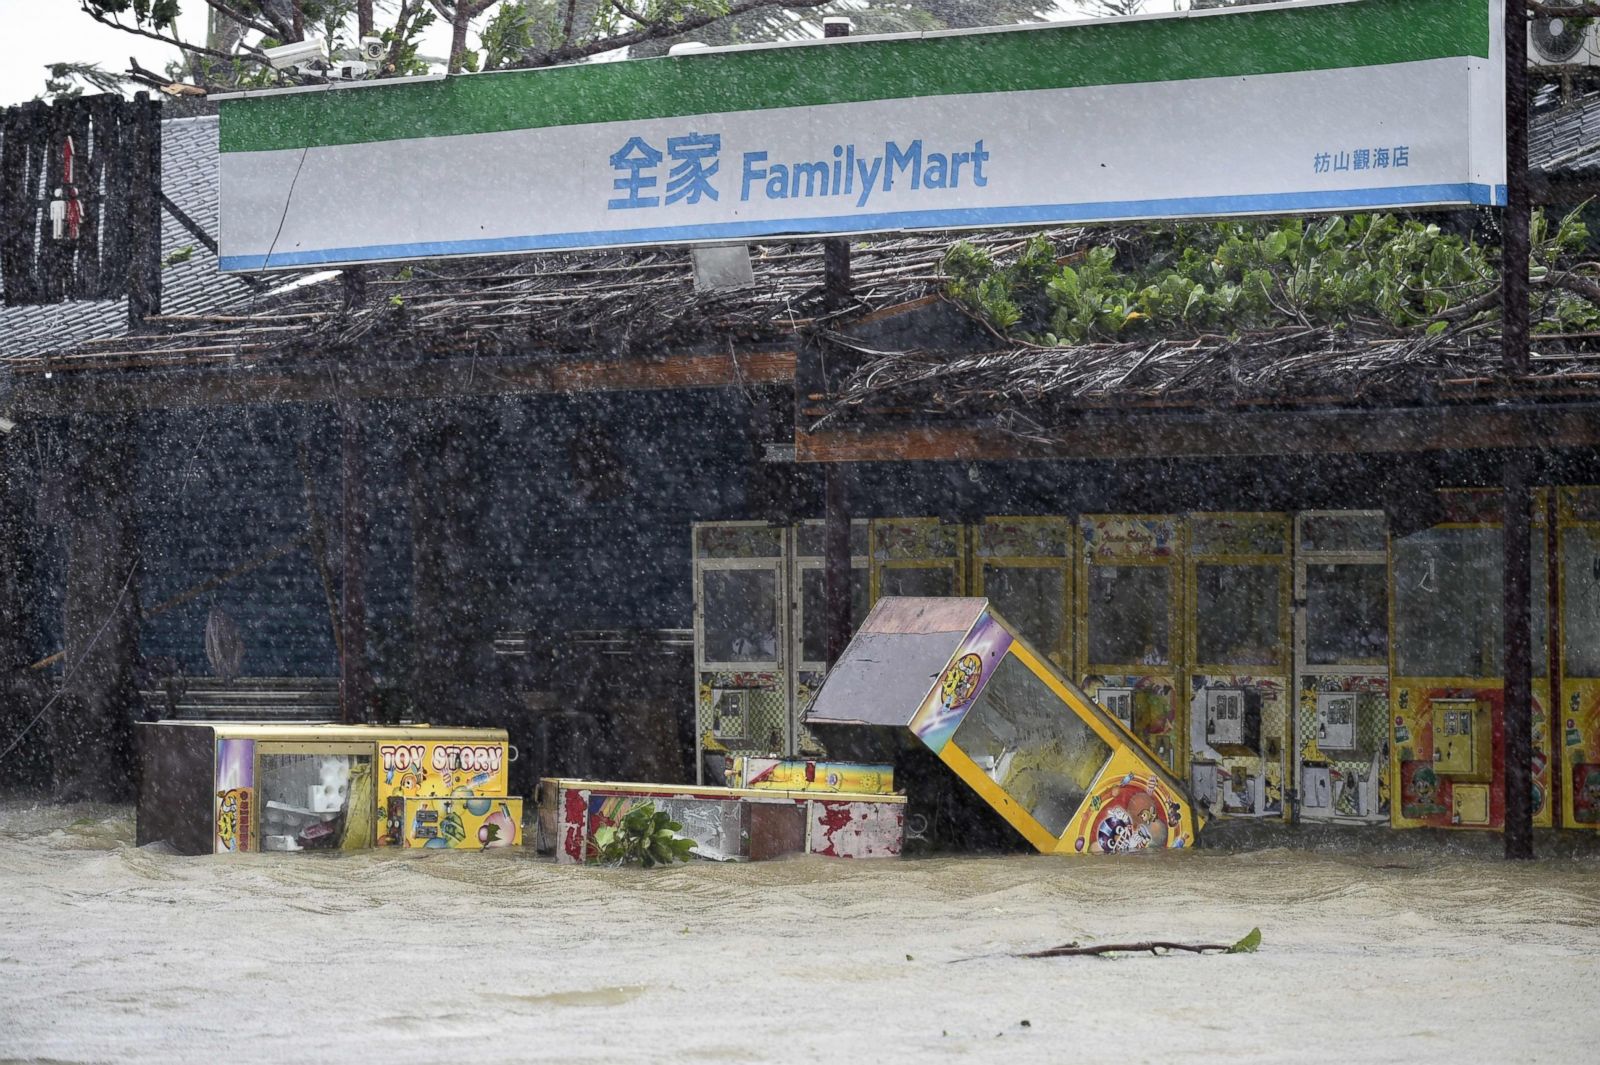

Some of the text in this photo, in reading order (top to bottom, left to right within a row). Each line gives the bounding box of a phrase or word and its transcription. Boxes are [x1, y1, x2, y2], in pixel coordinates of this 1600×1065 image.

[608, 132, 721, 209] 全家
[741, 139, 989, 207] FamilyMart
[1313, 145, 1410, 174] 枋山觀海店
[380, 745, 503, 772] TOY STORY
